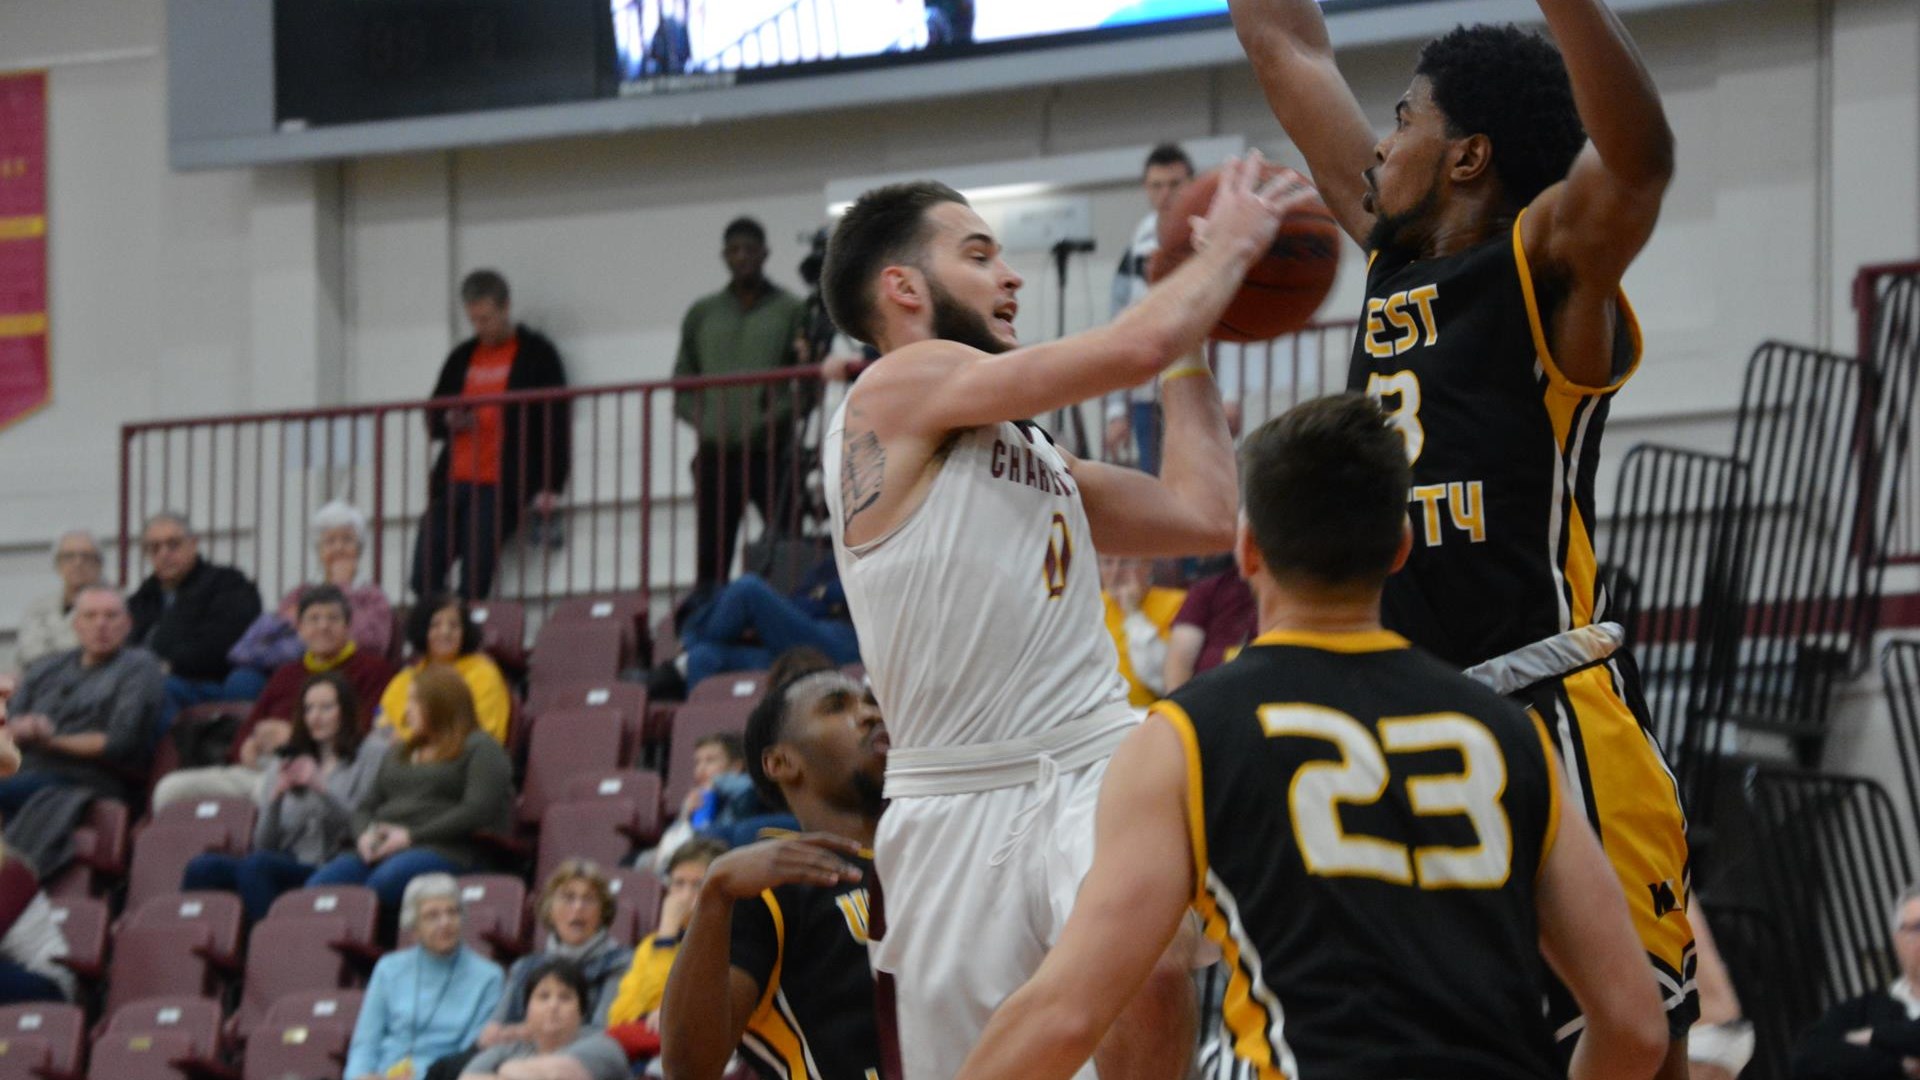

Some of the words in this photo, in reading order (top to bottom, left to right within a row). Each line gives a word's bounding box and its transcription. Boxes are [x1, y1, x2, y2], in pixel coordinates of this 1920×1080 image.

[1365, 284, 1439, 357] EST
[1407, 481, 1486, 547] TY
[1043, 511, 1073, 600] 0
[1257, 702, 1513, 890] 23
